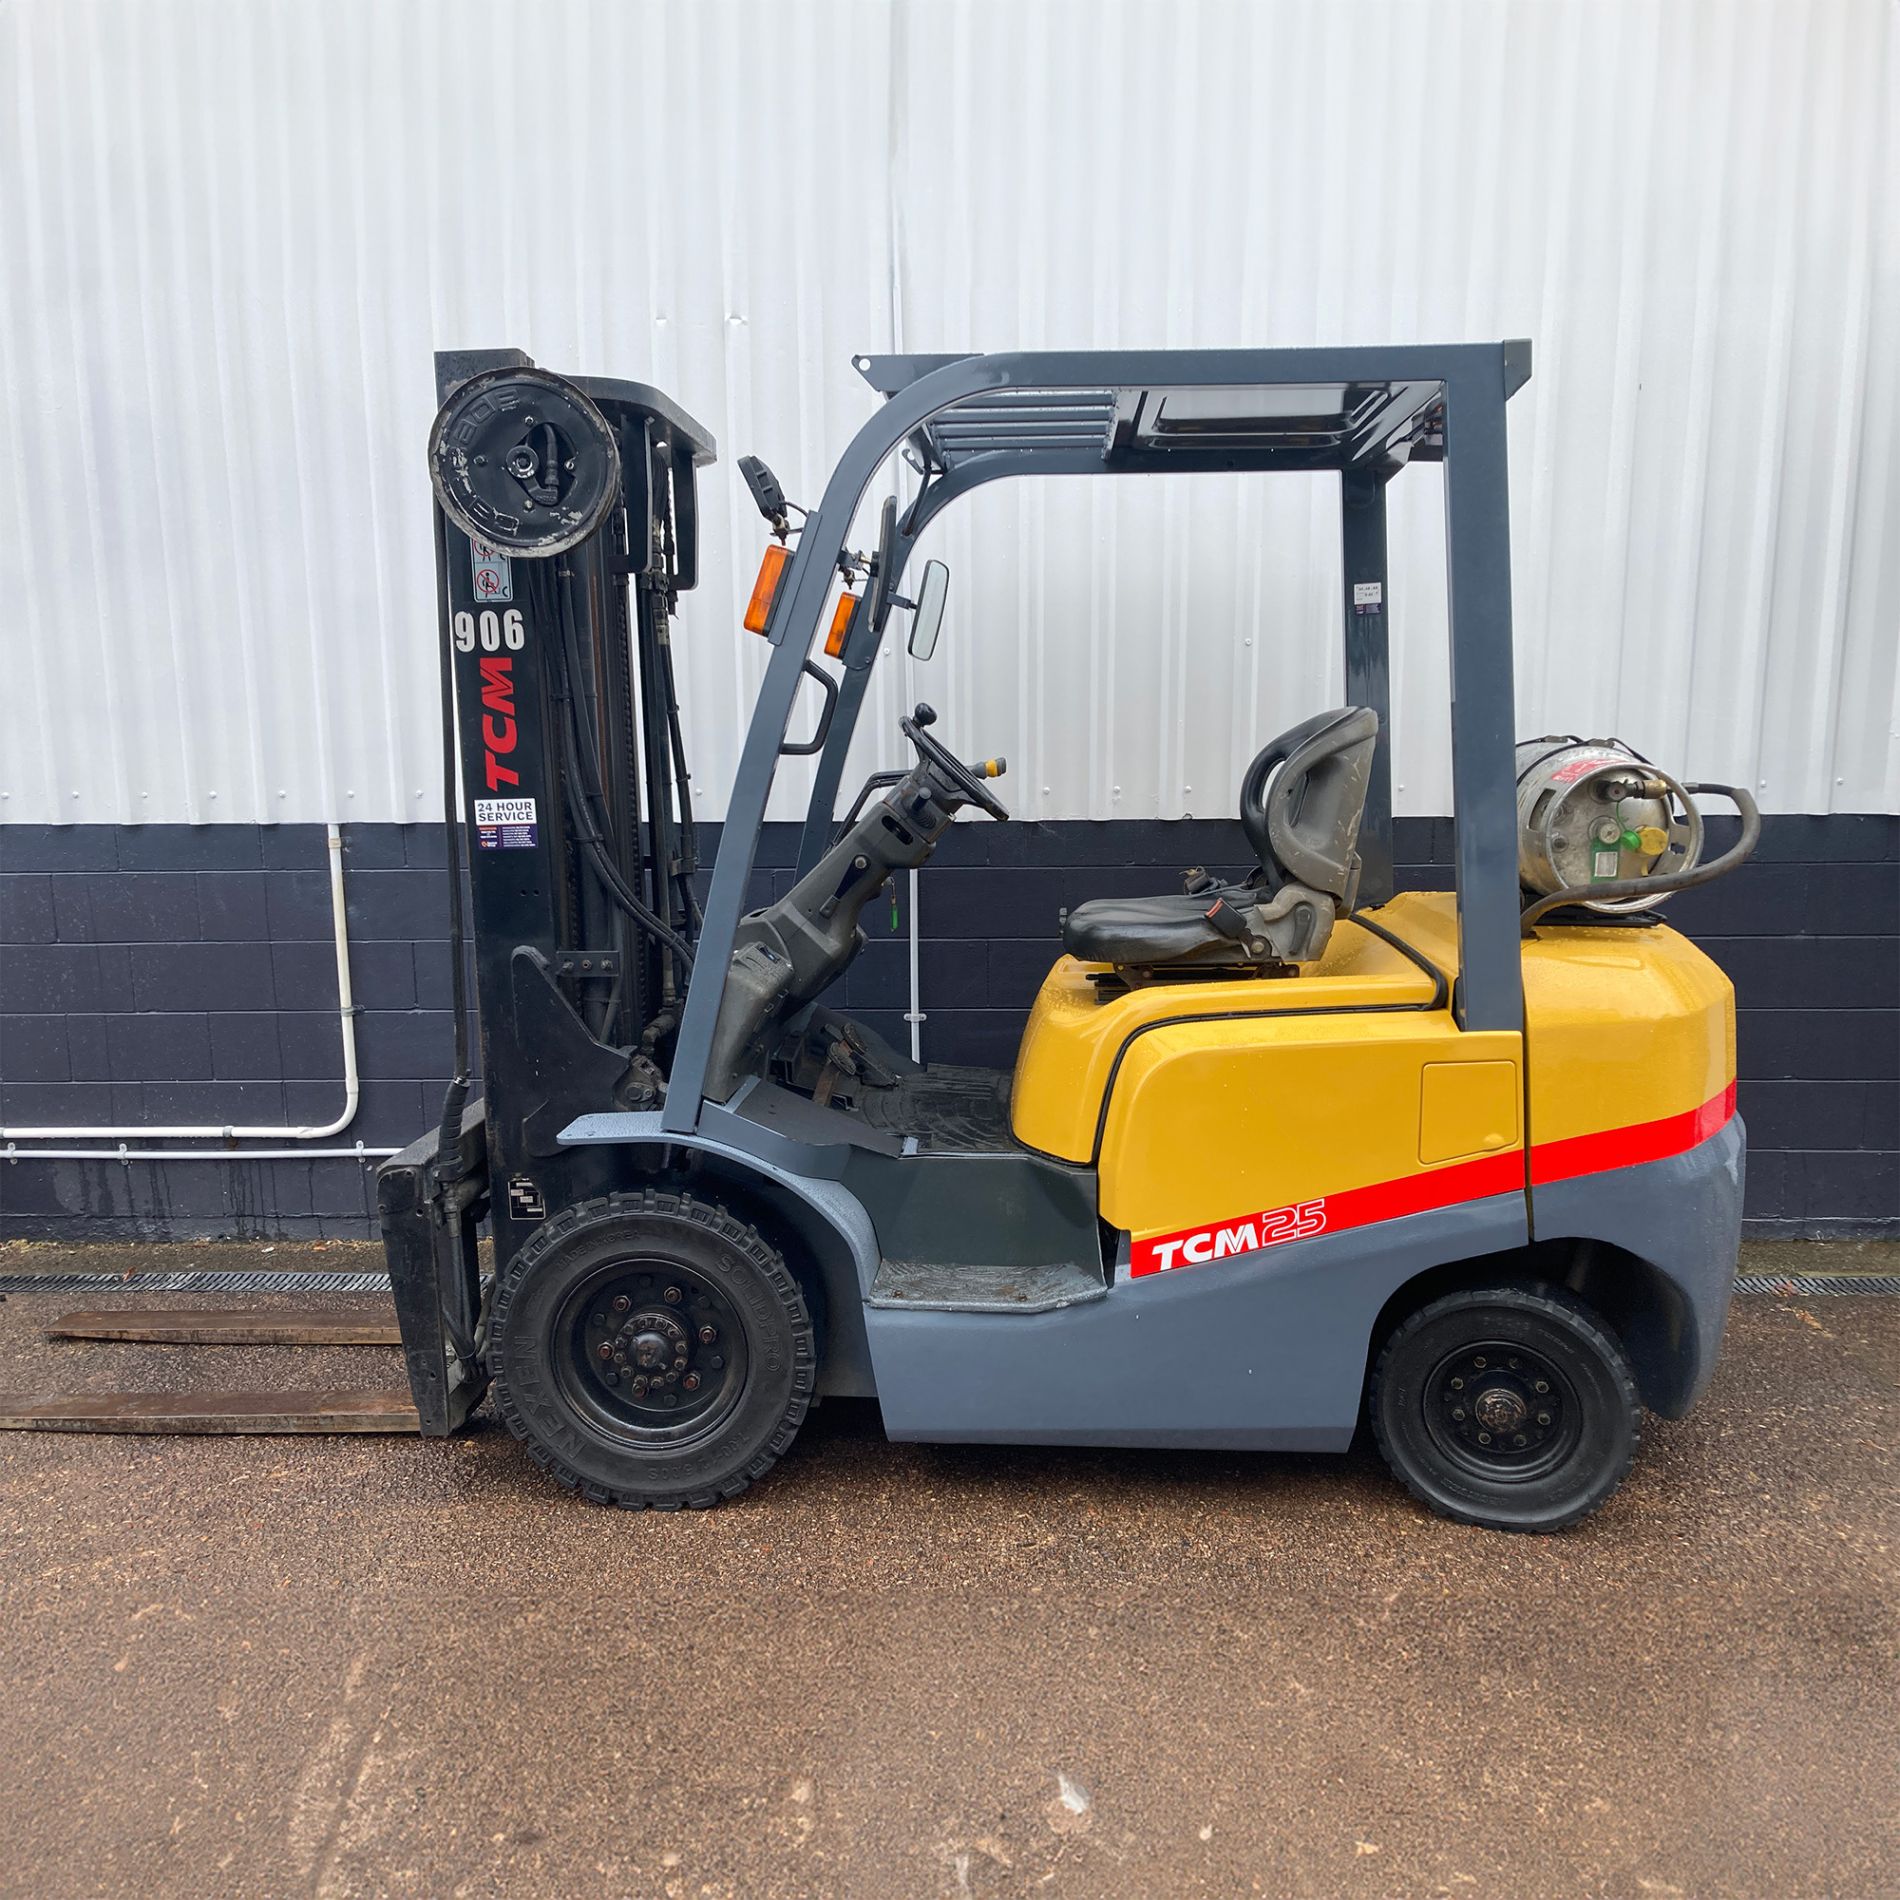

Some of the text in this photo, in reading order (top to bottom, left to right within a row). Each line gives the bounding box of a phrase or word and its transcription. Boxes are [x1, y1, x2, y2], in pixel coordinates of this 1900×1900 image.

[455, 608, 525, 652] 906
[479, 657, 519, 792] TCM
[477, 802, 532, 812] 24 HOUR
[478, 811, 533, 822] SERVICE
[1152, 1198, 1327, 1271] TCM 25
[717, 1253, 782, 1372] SOLIDPRO
[513, 1336, 588, 1460] NEXEN
